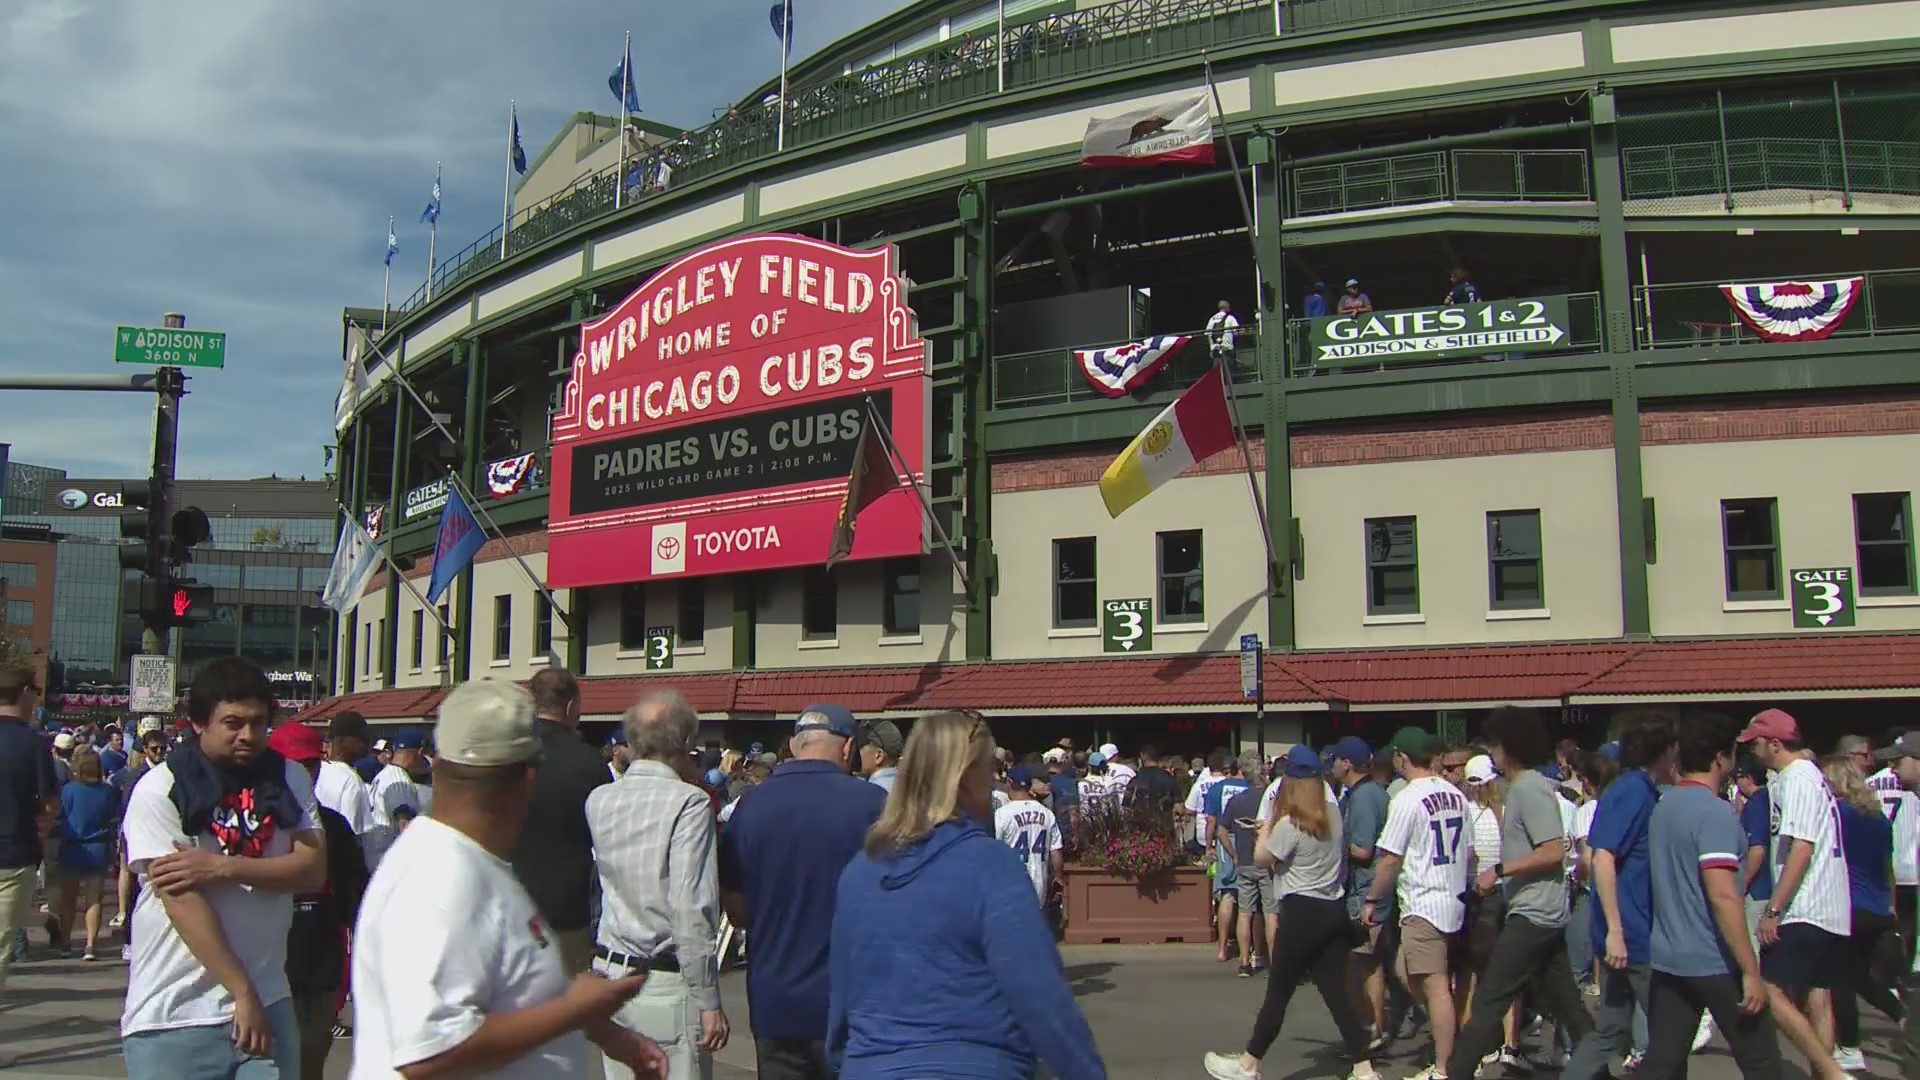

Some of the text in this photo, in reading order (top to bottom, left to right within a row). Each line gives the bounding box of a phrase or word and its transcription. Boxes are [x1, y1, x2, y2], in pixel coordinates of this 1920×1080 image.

[590, 254, 874, 376] WRIGLEY FIELD
[1325, 308, 1466, 341] GATES
[121, 331, 222, 350] W ADDISON ST
[658, 308, 788, 360] HOME OF
[1327, 328, 1551, 359] ADDISON & SHEFFIELD
[144, 349, 197, 362] 3600 N
[586, 337, 875, 431] CHICAGO CUBS
[594, 408, 861, 481] PADRES VS. CUBS
[605, 484, 631, 496] 2025
[637, 479, 664, 491] WILD
[668, 473, 700, 486] CARD
[706, 466, 740, 480] GAME
[747, 464, 753, 474] 2
[771, 457, 800, 471] 2:08
[807, 452, 838, 465] P.M.
[407, 482, 438, 506] GATES
[693, 525, 781, 556] TOYOTA
[1794, 569, 1848, 582] GATE
[1106, 600, 1149, 611] GATE
[1804, 582, 1843, 615] 3
[649, 628, 673, 636] GATE
[1112, 611, 1143, 641] 3
[651, 636, 669, 660] 3
[140, 660, 168, 668] NOTICE
[1421, 792, 1463, 816] BRYANT
[1014, 811, 1046, 828] RIZZO
[1013, 829, 1048, 863] 44
[1430, 816, 1463, 866] 17
